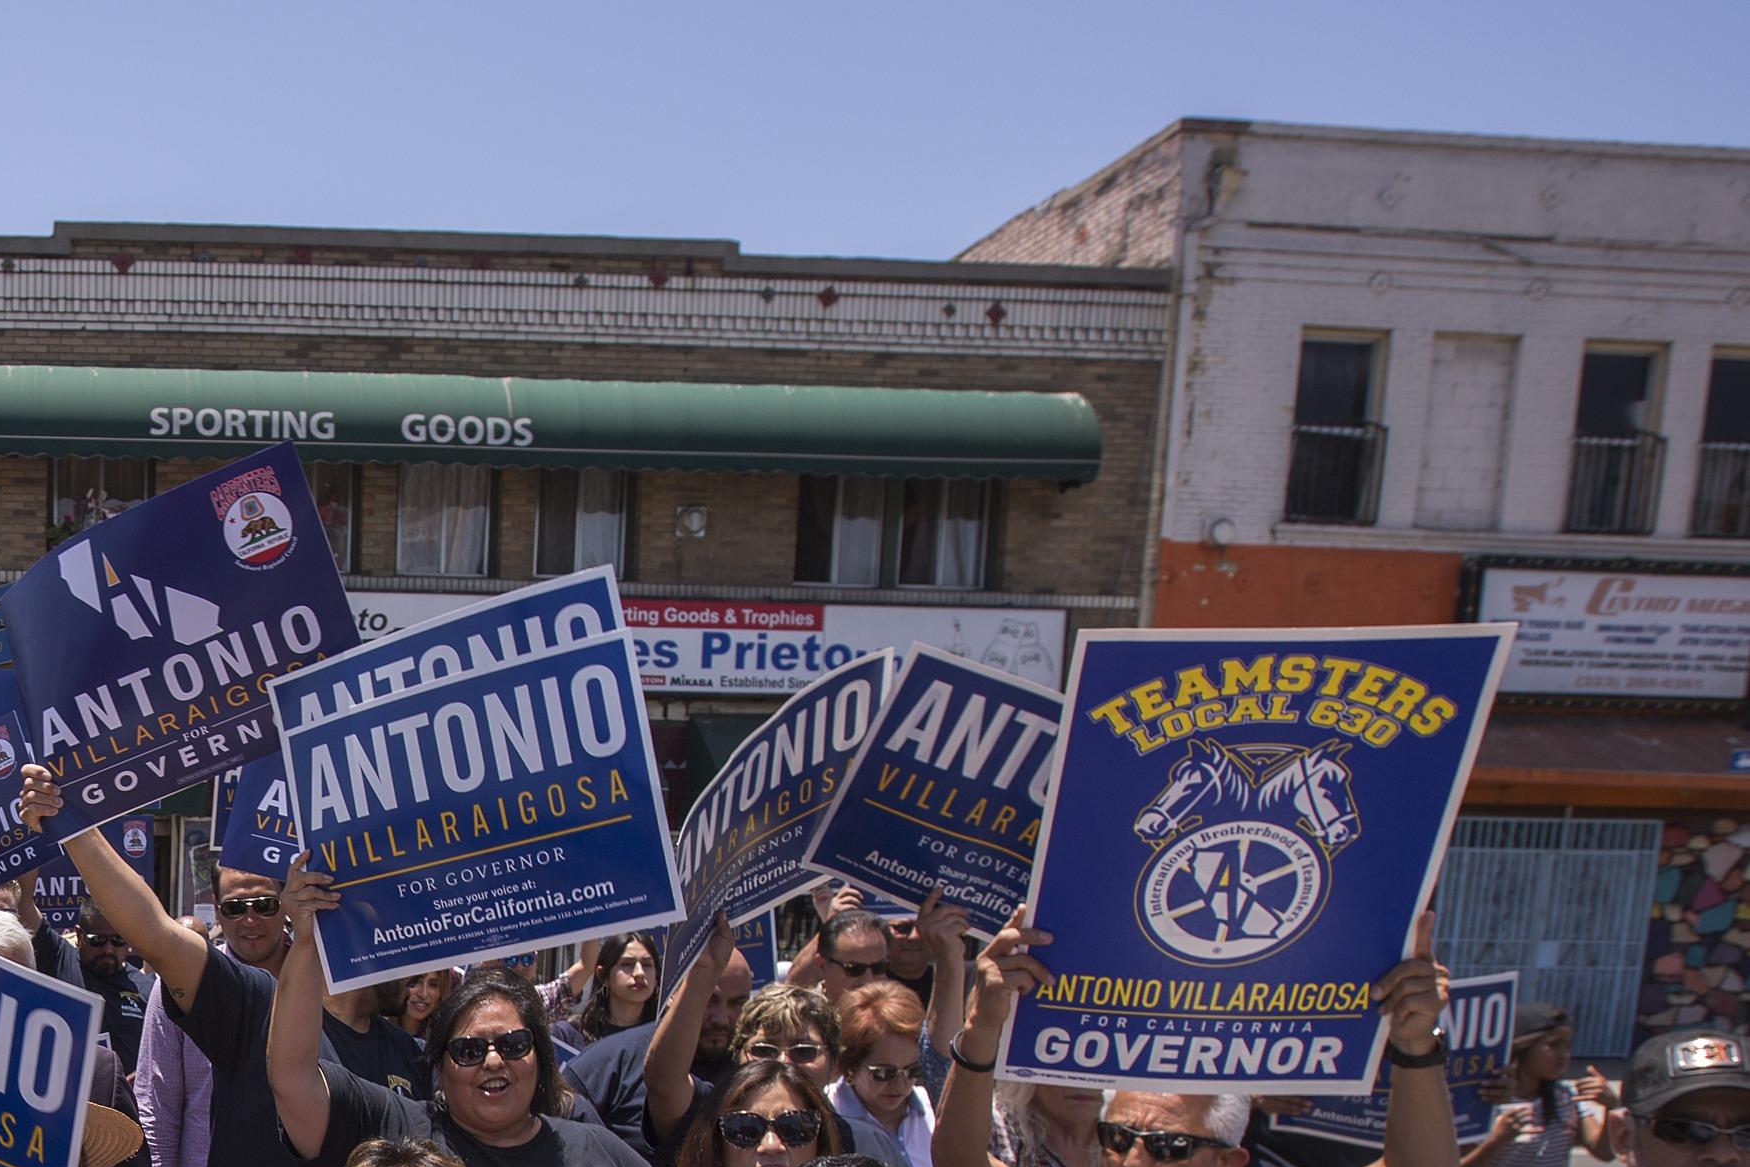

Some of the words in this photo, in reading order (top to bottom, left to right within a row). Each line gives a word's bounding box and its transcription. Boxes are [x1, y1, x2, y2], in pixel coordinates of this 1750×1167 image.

[151, 406, 335, 441] SPORTING
[401, 412, 534, 446] GOODS
[664, 607, 719, 625] Goods
[724, 608, 737, 624] &
[741, 609, 815, 628] Trophies
[43, 604, 322, 758] ANTONIO
[720, 676, 784, 689] Established
[1088, 654, 1457, 738] TEAMSTERS
[182, 724, 210, 743] FOR
[311, 663, 627, 832] ANTONIO
[1127, 693, 1299, 757] LOCAL
[1306, 697, 1402, 749] 630
[81, 719, 263, 805] GOVERN
[678, 679, 871, 887] ANTONIO
[320, 768, 630, 873] VILLARAIGOSA
[877, 761, 1041, 847] VILLARA
[917, 835, 958, 860] FOR
[1199, 824, 1298, 850] Brotherhood
[1294, 845, 1311, 861] of
[397, 876, 437, 898] FOR
[445, 846, 567, 888] GOVERNOR
[433, 893, 465, 911] Share
[465, 889, 490, 906] your
[490, 883, 519, 898] voice
[521, 879, 537, 890] at:
[1150, 838, 1198, 918] International
[1285, 858, 1316, 924] Teamsters
[372, 879, 616, 946] AntonioForCalifornia.com
[1036, 974, 1163, 1009] ANTONIO
[1168, 980, 1371, 1013] VILLARAIGOSA
[1080, 1014, 1128, 1029] FOR
[1146, 1018, 1313, 1034] CALIFORNIA
[1034, 1026, 1343, 1076] GOVERNOR
